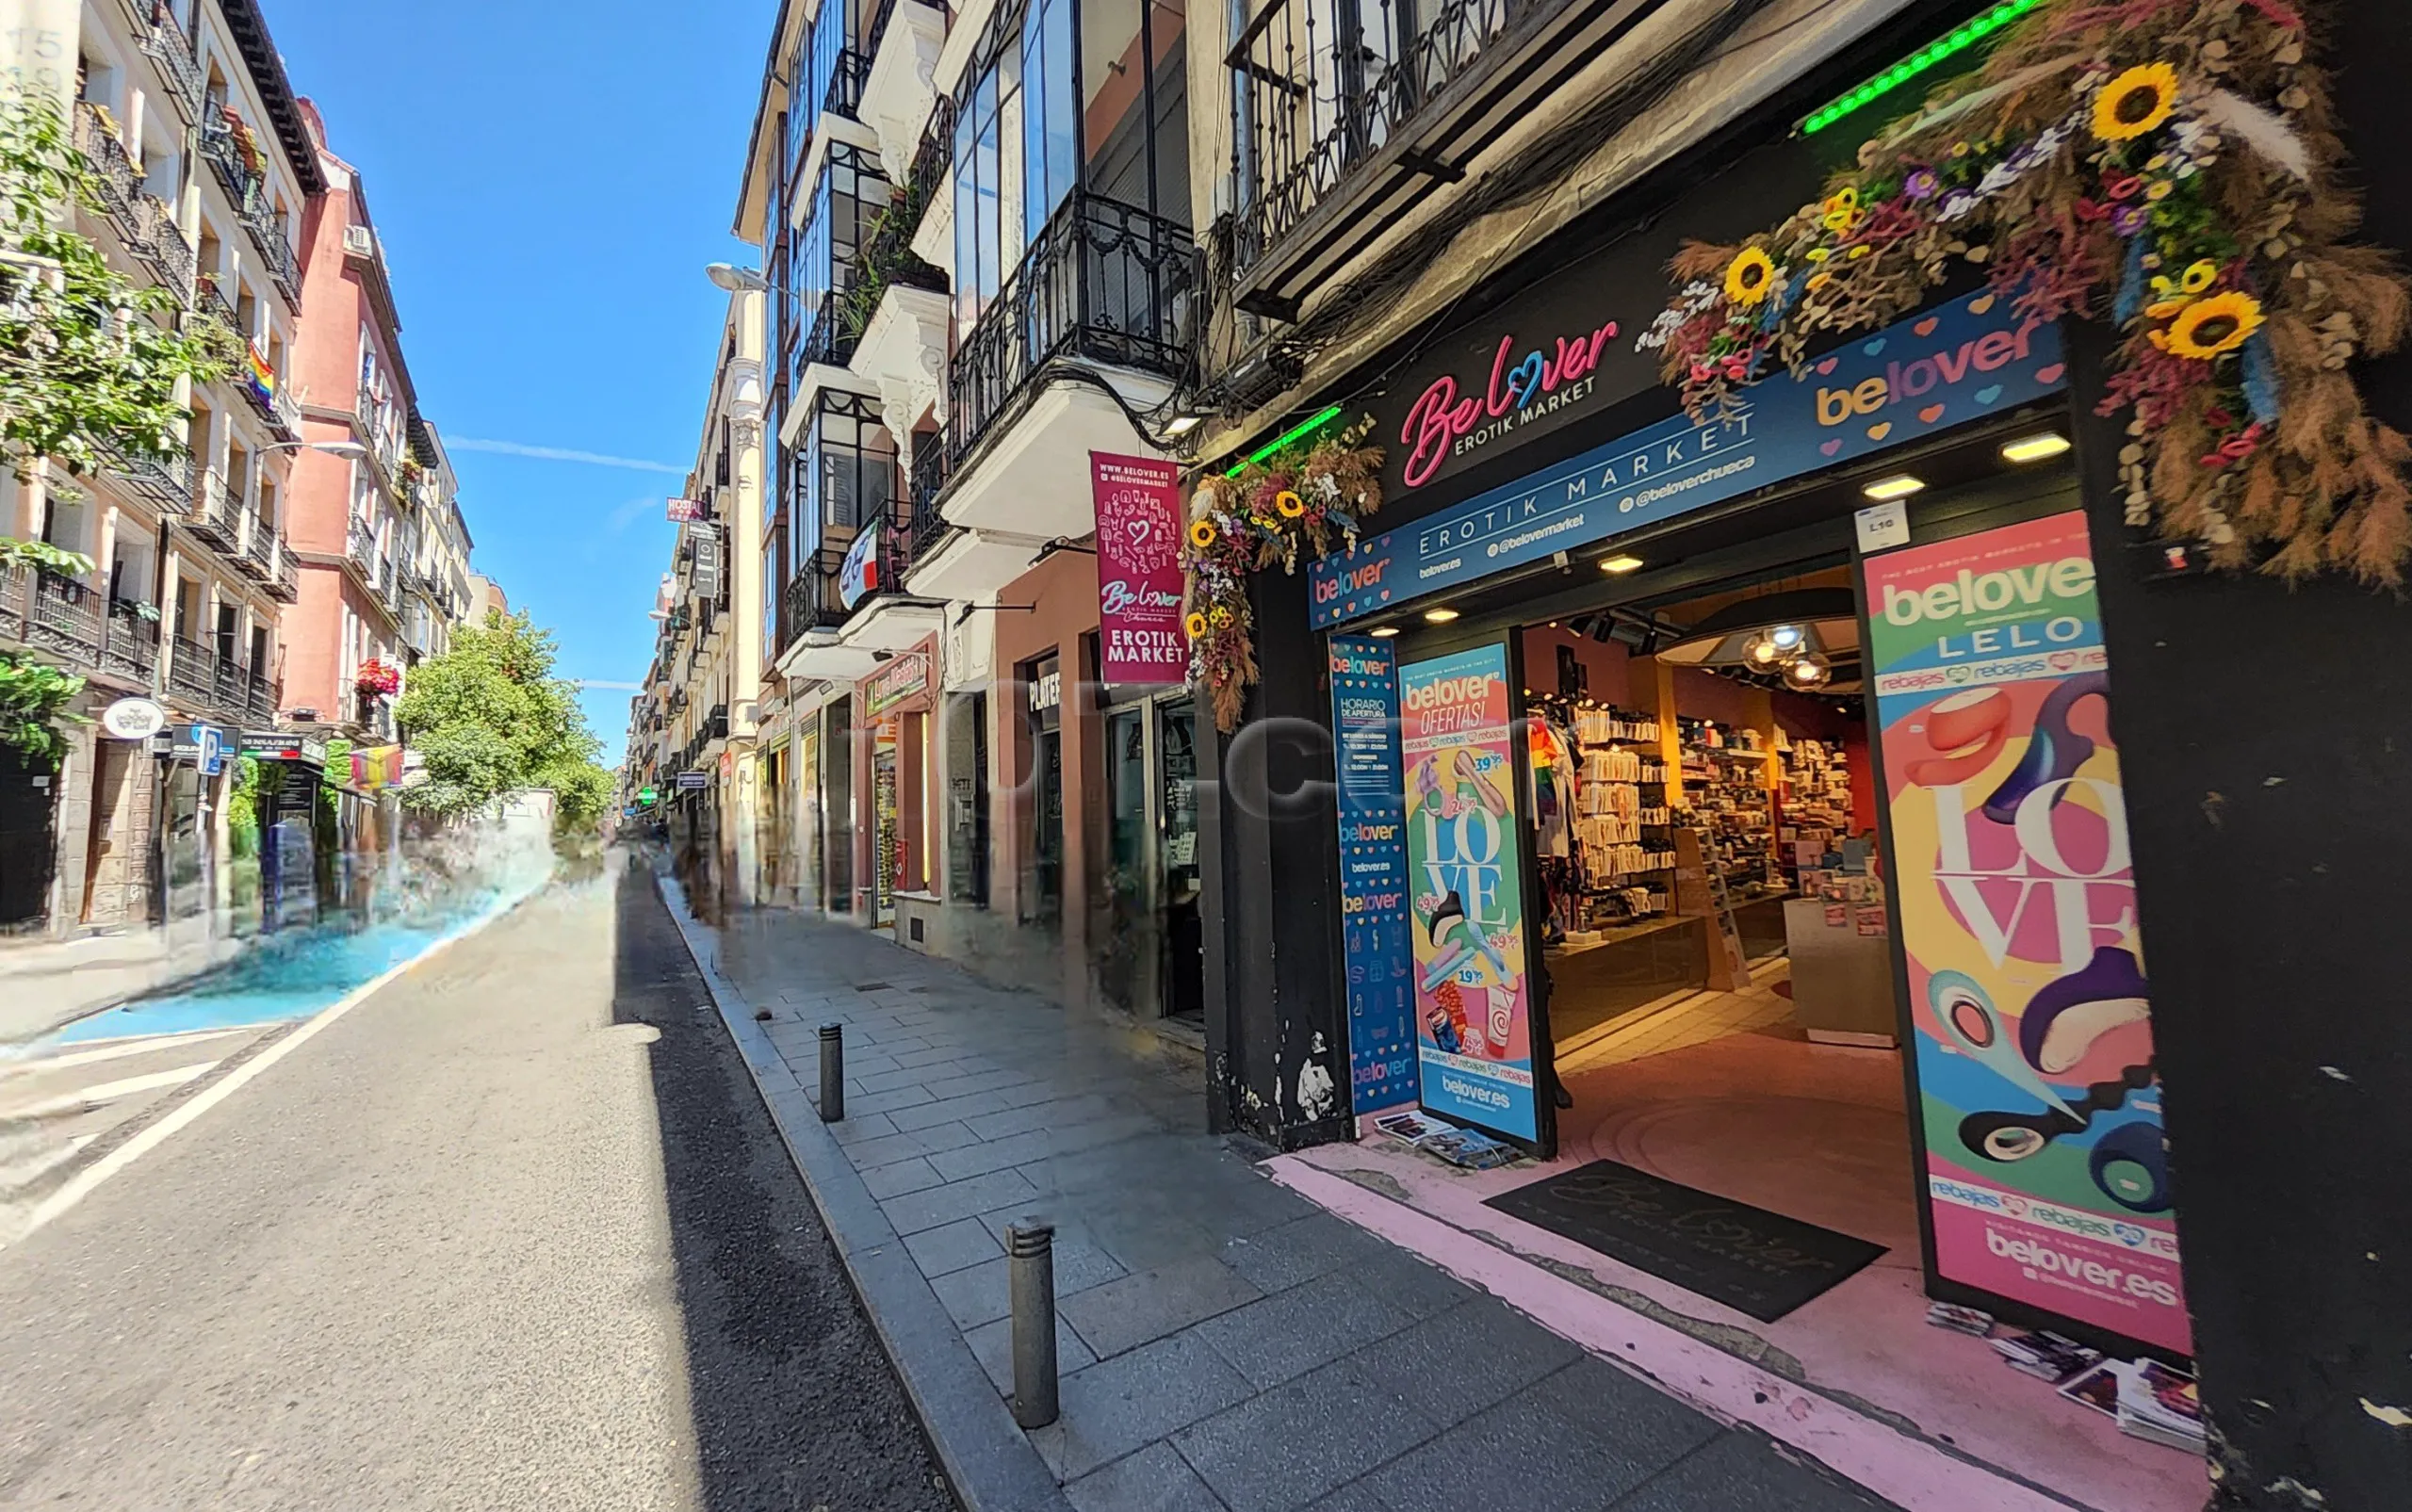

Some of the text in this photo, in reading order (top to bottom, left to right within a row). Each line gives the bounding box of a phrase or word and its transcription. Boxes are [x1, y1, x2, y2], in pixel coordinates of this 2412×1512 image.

[1817, 316, 2041, 427] belover
[1455, 376, 1595, 456] EROTIK MARKET
[1420, 412, 1753, 555] EROTIK MARKET
[1315, 559, 1387, 604] belover
[1108, 629, 1183, 663] EROTIK MARKET
[1938, 616, 2084, 658] LELO
[1329, 655, 1389, 675] belover
[1881, 658, 2046, 691] rebajas rebajas
[1341, 698, 1386, 711] HORARIO
[1406, 675, 1492, 710] belover
[1421, 701, 1485, 735] OFERTAS!
[206, 733, 218, 759] P
[1341, 822, 1394, 841] belover
[1352, 861, 1391, 873] belover.es
[1343, 892, 1397, 914] belover
[1353, 1056, 1409, 1084] belover
[1442, 1074, 1510, 1109] belover.es
[1931, 1179, 2111, 1238] rebajas rebajas
[1986, 1227, 2176, 1307] belover.es
